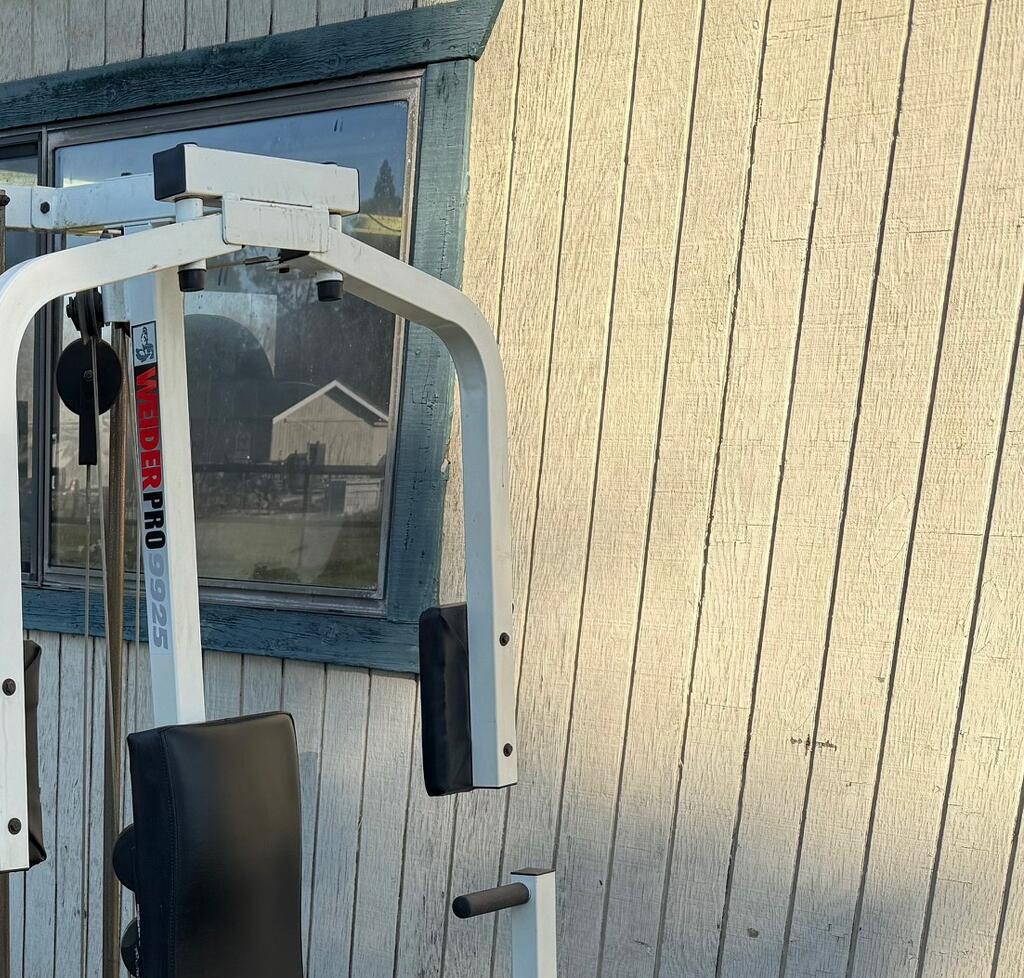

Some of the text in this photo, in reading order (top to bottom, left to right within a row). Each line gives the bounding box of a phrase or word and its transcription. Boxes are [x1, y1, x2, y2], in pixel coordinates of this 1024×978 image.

[136, 366, 169, 650] WEIDER PRO 9925
